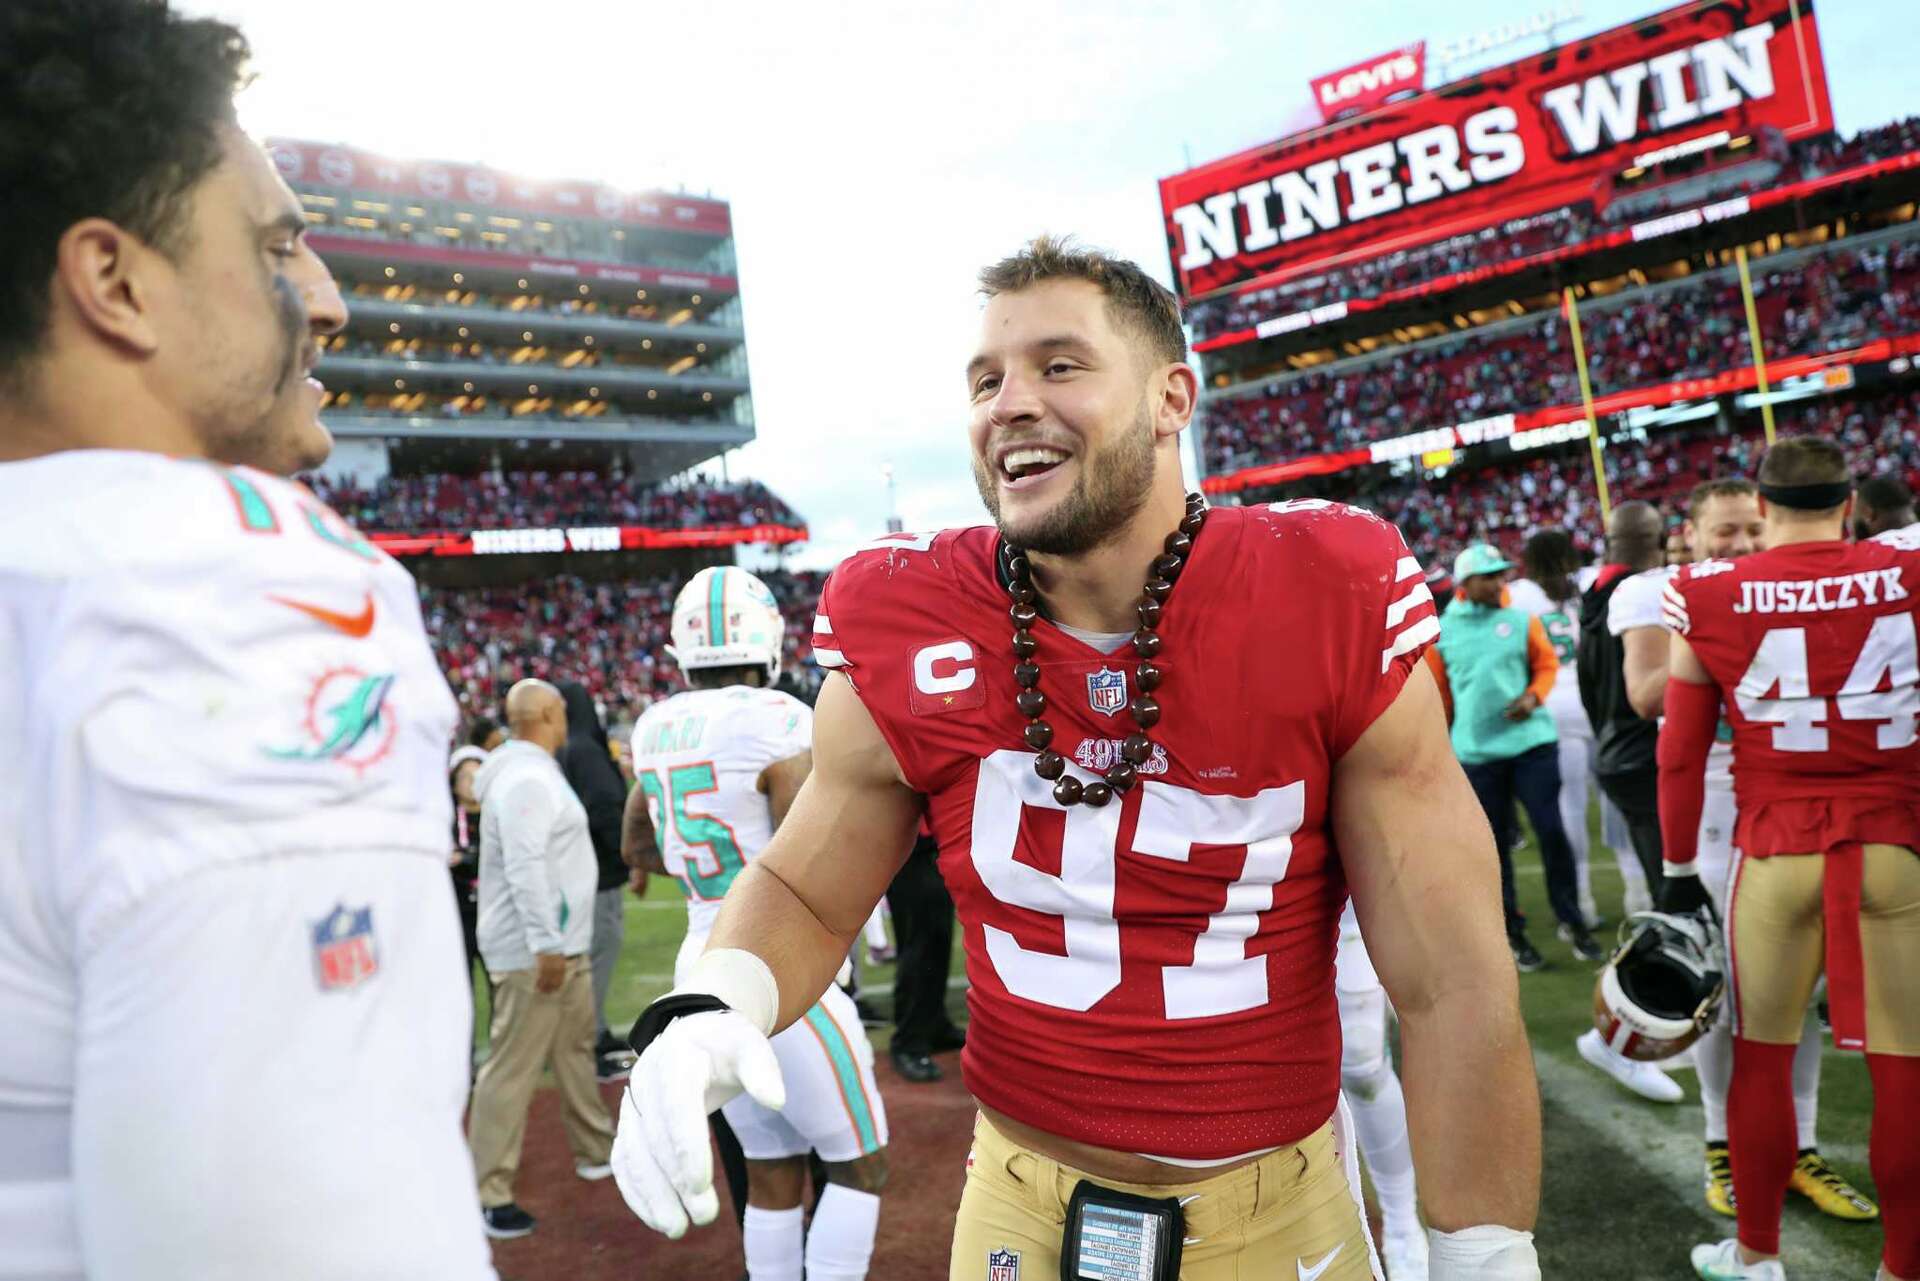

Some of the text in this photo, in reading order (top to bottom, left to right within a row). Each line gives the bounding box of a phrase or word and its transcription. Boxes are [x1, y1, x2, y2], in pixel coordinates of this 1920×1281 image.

[1173, 20, 1775, 271] NINERS WIN
[471, 527, 621, 554] NINERS WIN
[1733, 566, 1908, 614] JUSZCZYK
[914, 641, 976, 695] C
[1734, 611, 1920, 752] 44
[1094, 687, 1122, 708] NFL
[970, 748, 1305, 1020] 97
